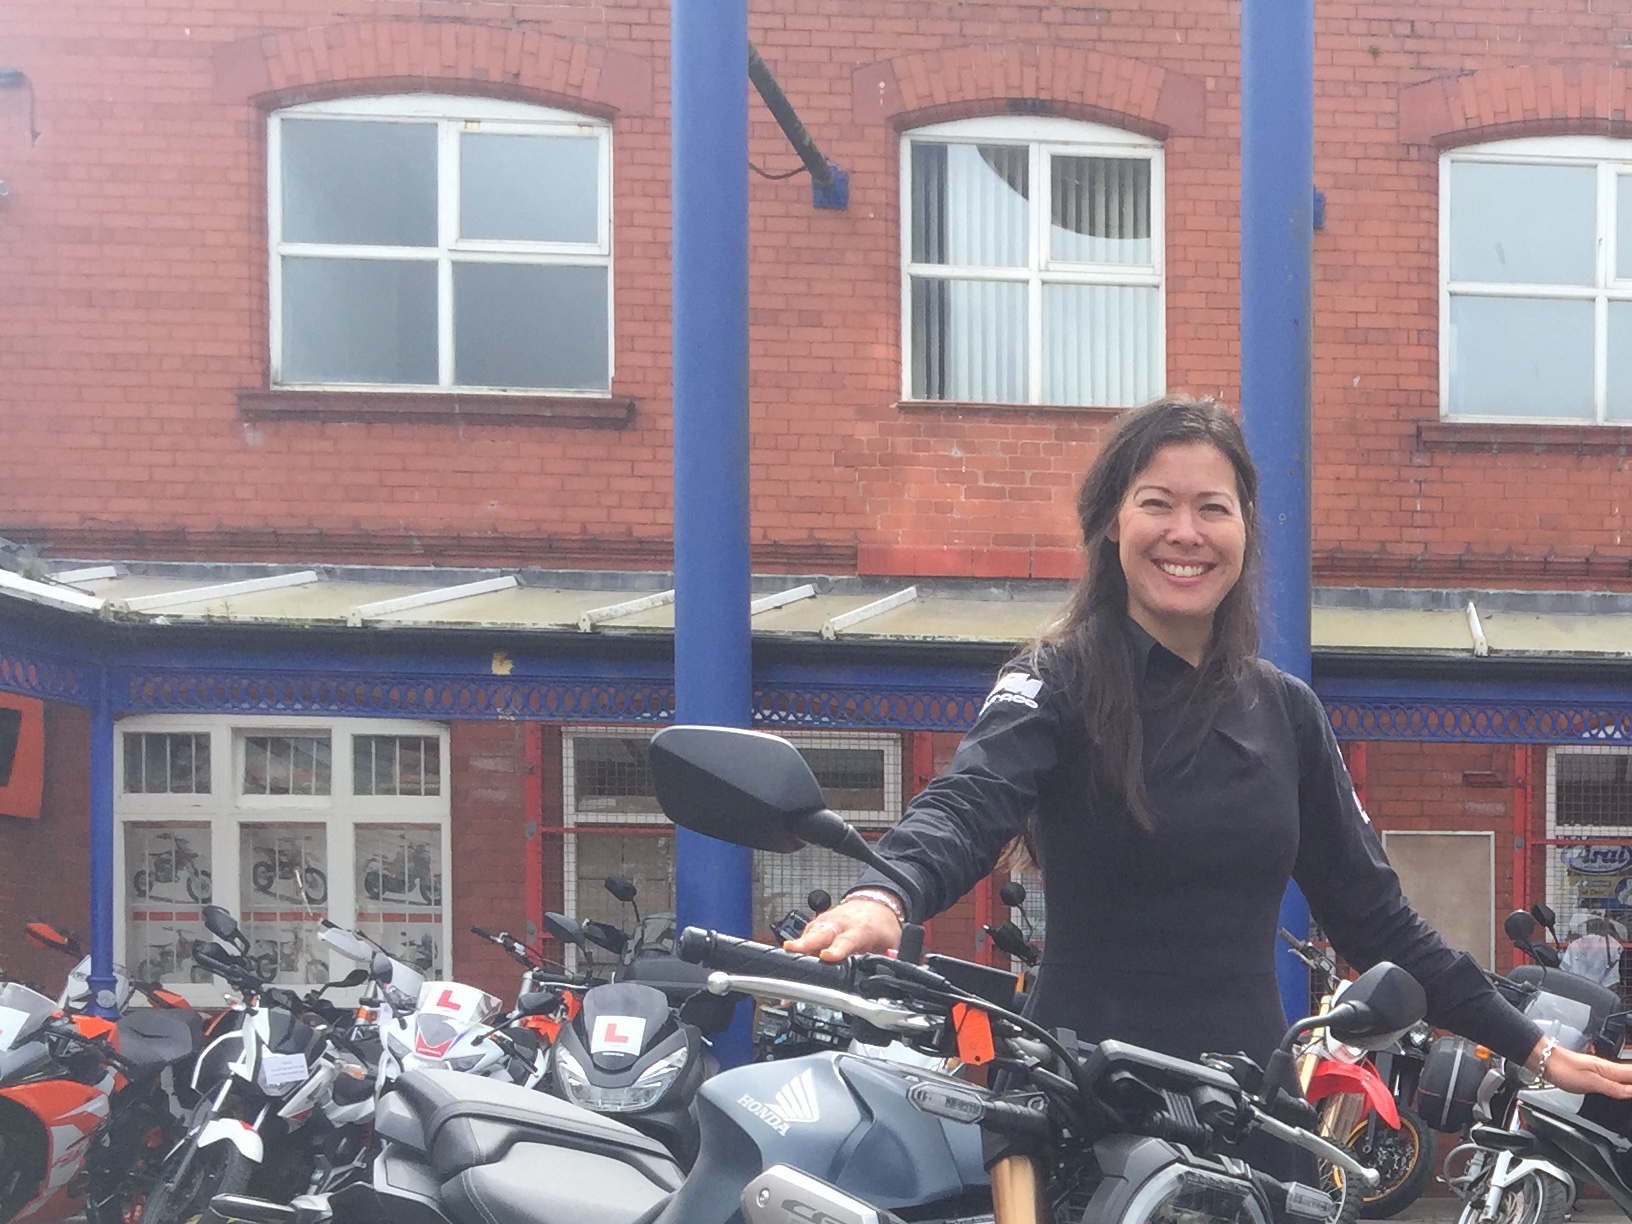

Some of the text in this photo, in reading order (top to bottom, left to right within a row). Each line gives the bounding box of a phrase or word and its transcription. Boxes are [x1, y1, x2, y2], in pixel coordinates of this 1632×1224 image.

[436, 990, 461, 1011] L
[604, 1023, 629, 1044] L
[736, 1092, 791, 1137] HONDA
